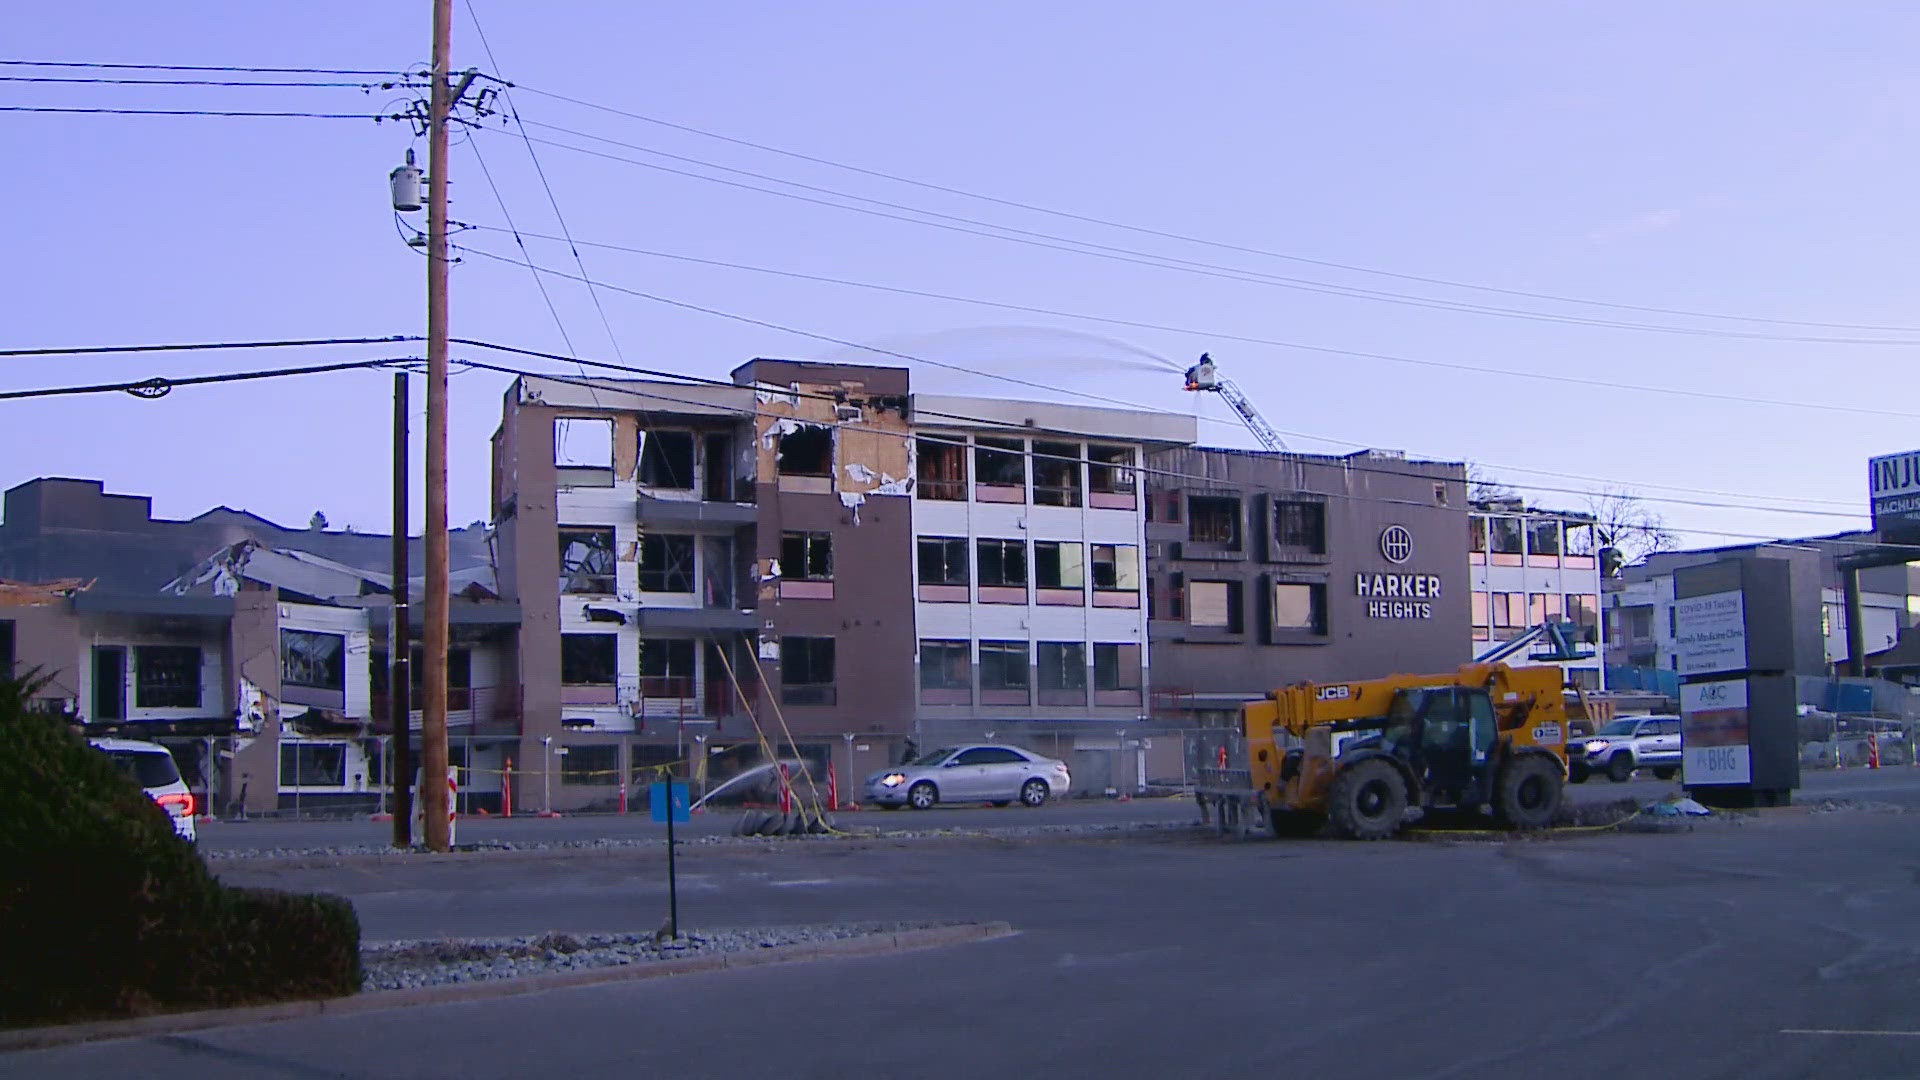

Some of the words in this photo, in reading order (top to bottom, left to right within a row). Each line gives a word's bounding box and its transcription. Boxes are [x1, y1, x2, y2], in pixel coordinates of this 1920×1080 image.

[1356, 574, 1441, 598] HARKER
[1369, 601, 1431, 619] HEIGHTS
[1316, 685, 1348, 700] JCB
[1708, 747, 1736, 770] BHG
